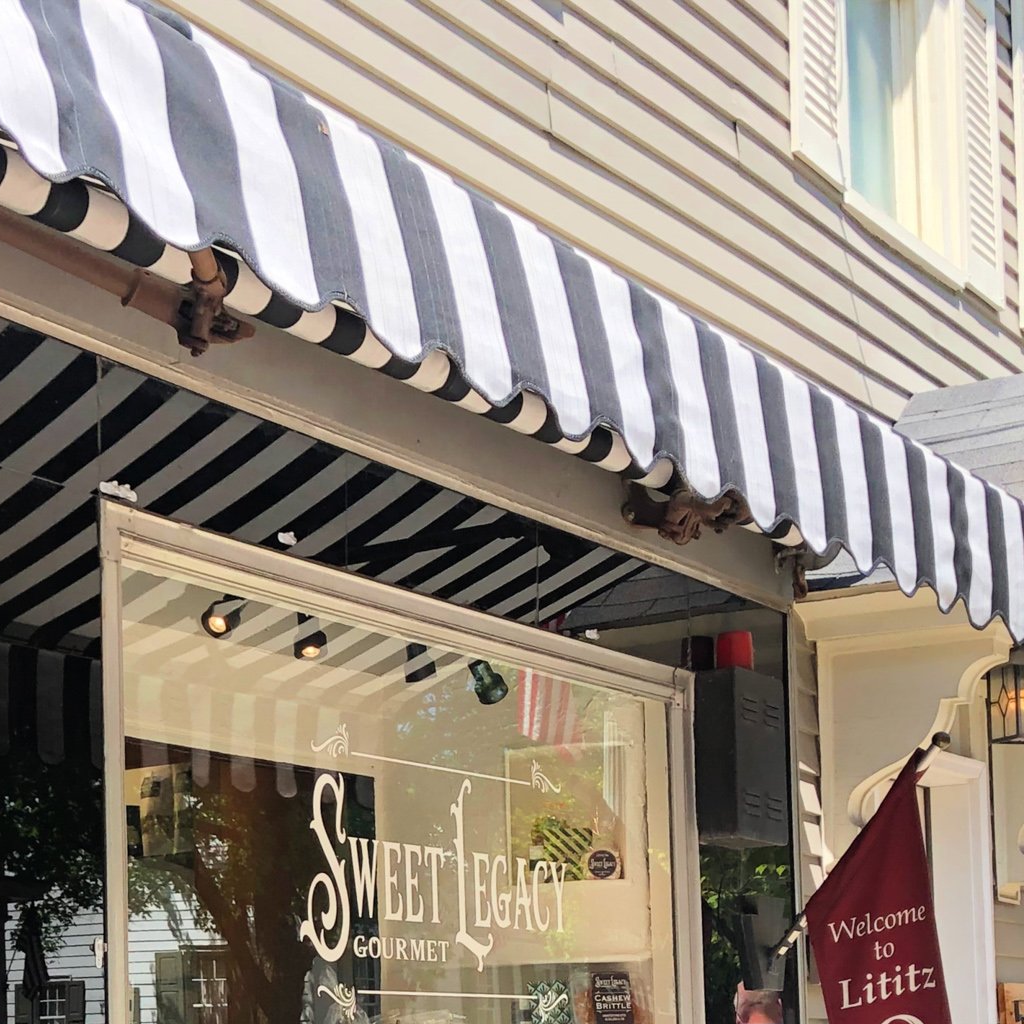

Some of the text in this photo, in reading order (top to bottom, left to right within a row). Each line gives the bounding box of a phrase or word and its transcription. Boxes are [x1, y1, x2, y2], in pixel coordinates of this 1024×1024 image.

[299, 772, 568, 973] SWEET LEGACY
[827, 903, 927, 944] Welcome
[353, 934, 450, 963] GOURMET
[873, 940, 896, 962] to
[594, 994, 631, 1002] CASHEW
[839, 963, 937, 1011] Lititz
[596, 1002, 632, 1010] BRITTLE
